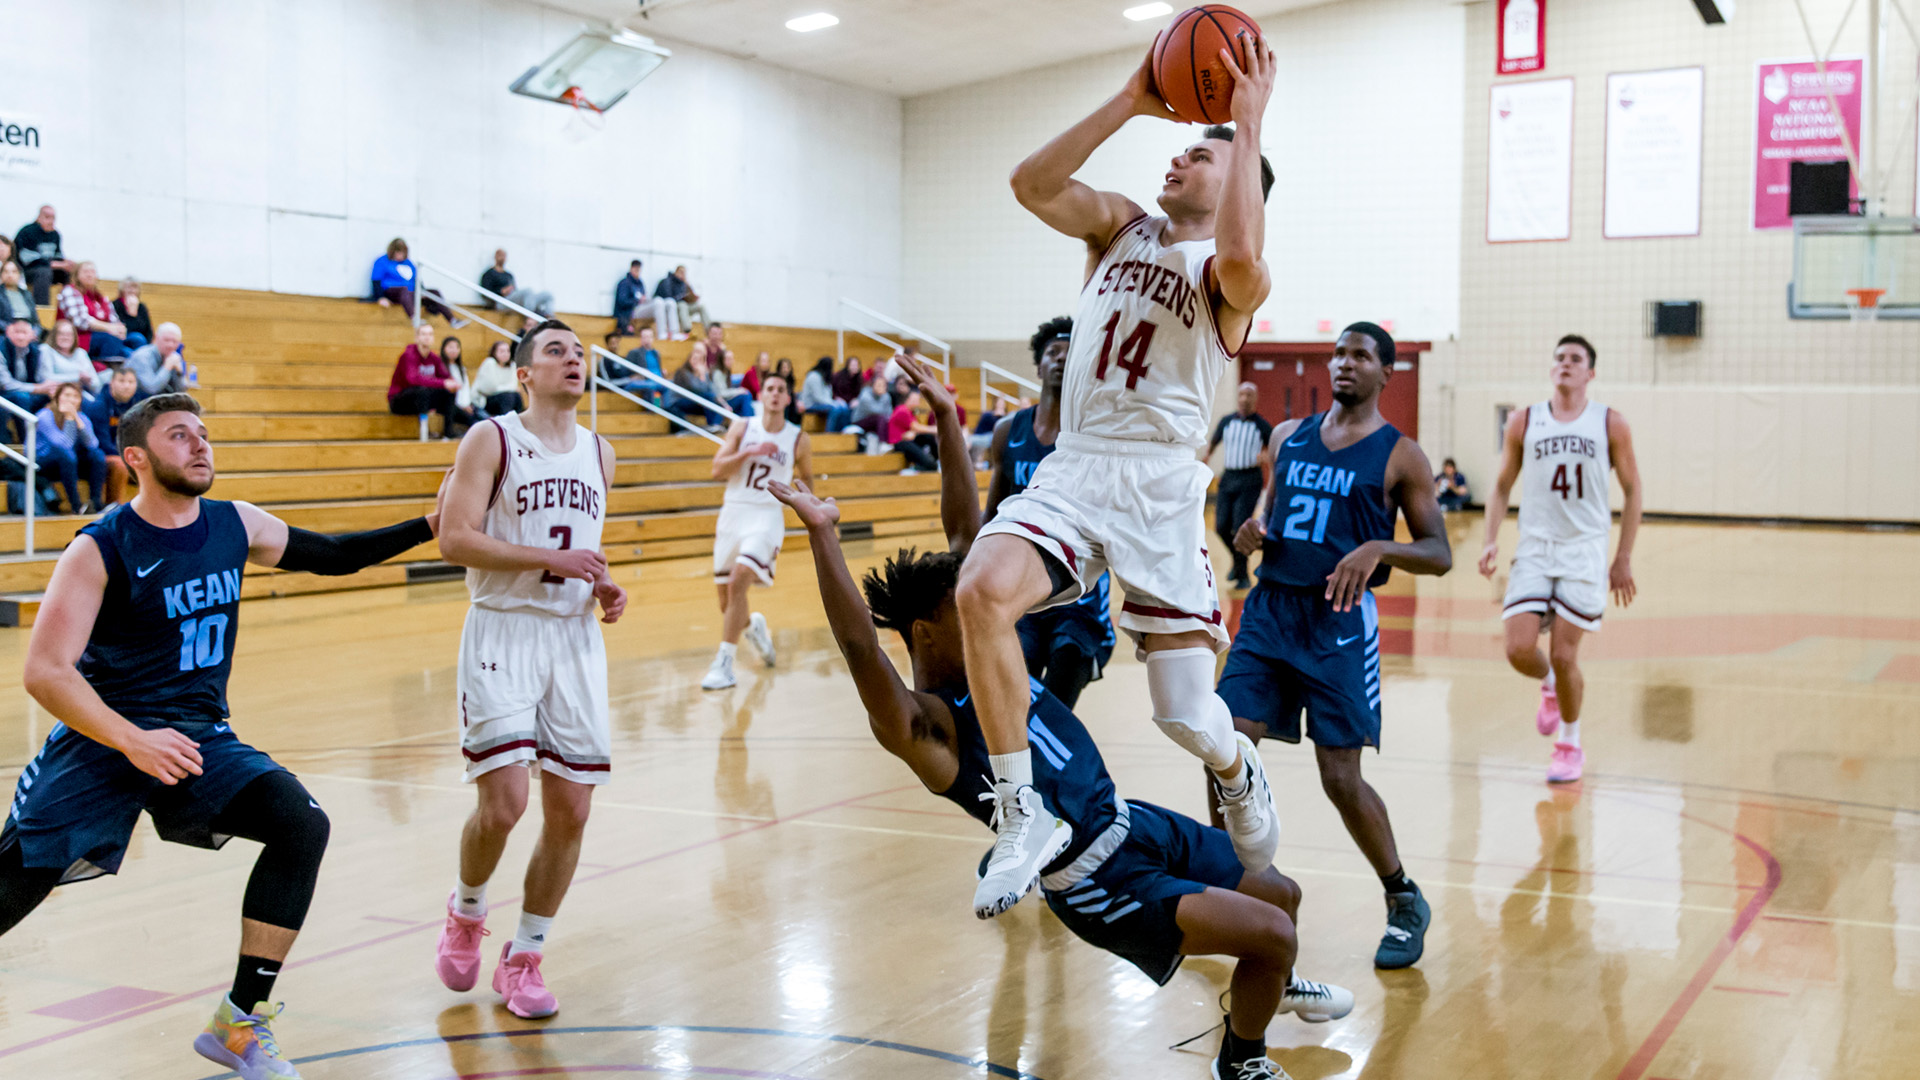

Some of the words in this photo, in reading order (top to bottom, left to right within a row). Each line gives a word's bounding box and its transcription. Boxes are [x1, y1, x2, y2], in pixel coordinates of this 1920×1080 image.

[1200, 69, 1215, 101] ROCK
[1098, 260, 1197, 330] STEVENS
[1096, 310, 1158, 392] 14
[1535, 435, 1595, 460] STEVENS
[516, 478, 599, 521] STEVENS
[746, 462, 771, 491] 12
[1285, 460, 1356, 497] KEAN
[1551, 463, 1583, 500] 41
[1282, 493, 1333, 544] 21
[540, 526, 571, 584] 2
[163, 568, 240, 619] KEAN
[179, 613, 229, 671] 10
